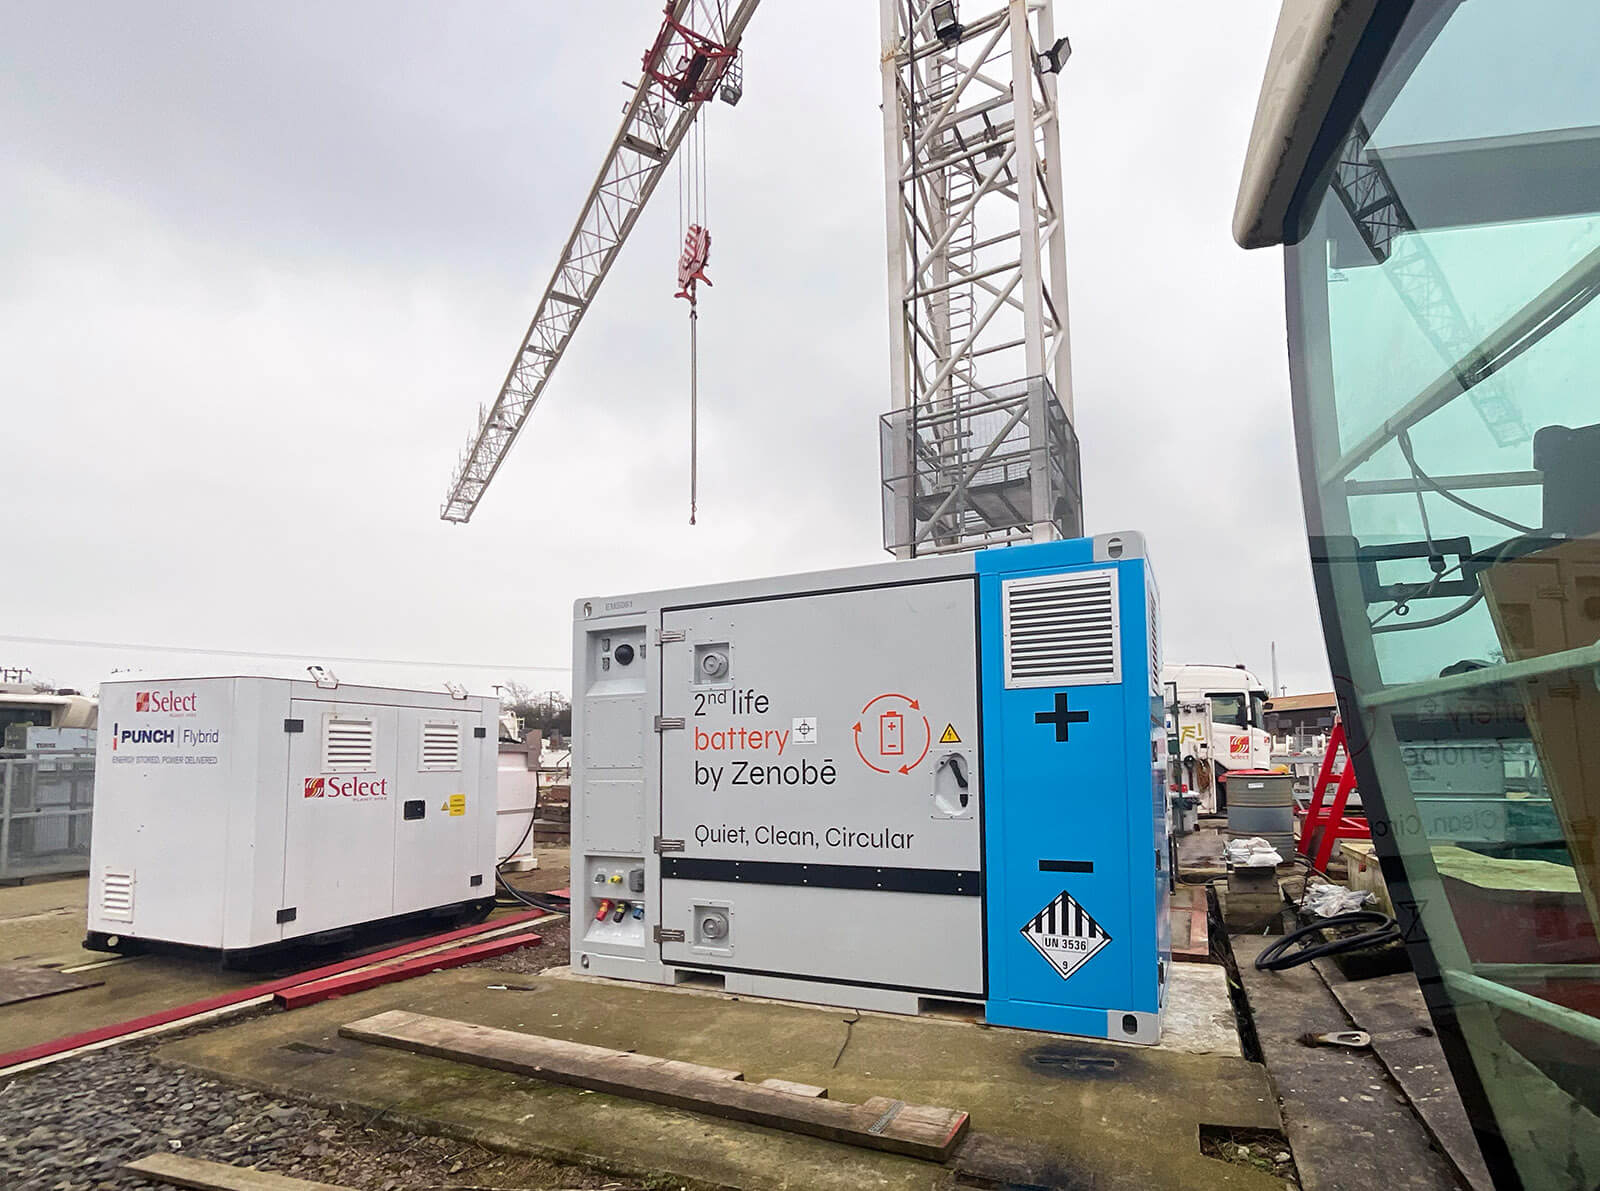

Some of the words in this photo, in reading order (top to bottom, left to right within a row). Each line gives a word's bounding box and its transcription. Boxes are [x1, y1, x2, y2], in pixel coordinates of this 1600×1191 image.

[151, 690, 197, 712] Select
[732, 689, 769, 715] life
[121, 730, 174, 743] PUNCH
[183, 729, 219, 746] Flybrid
[694, 726, 789, 755] battery
[694, 760, 723, 791] by
[731, 759, 837, 785] Zenobē
[328, 776, 387, 798] Select
[694, 824, 749, 848] Quiet,
[755, 825, 819, 849] Clean,
[825, 827, 915, 849] Circular
[1044, 937, 1059, 948] UN
[1062, 939, 1087, 951] 3536
[1062, 961, 1068, 969] 9
